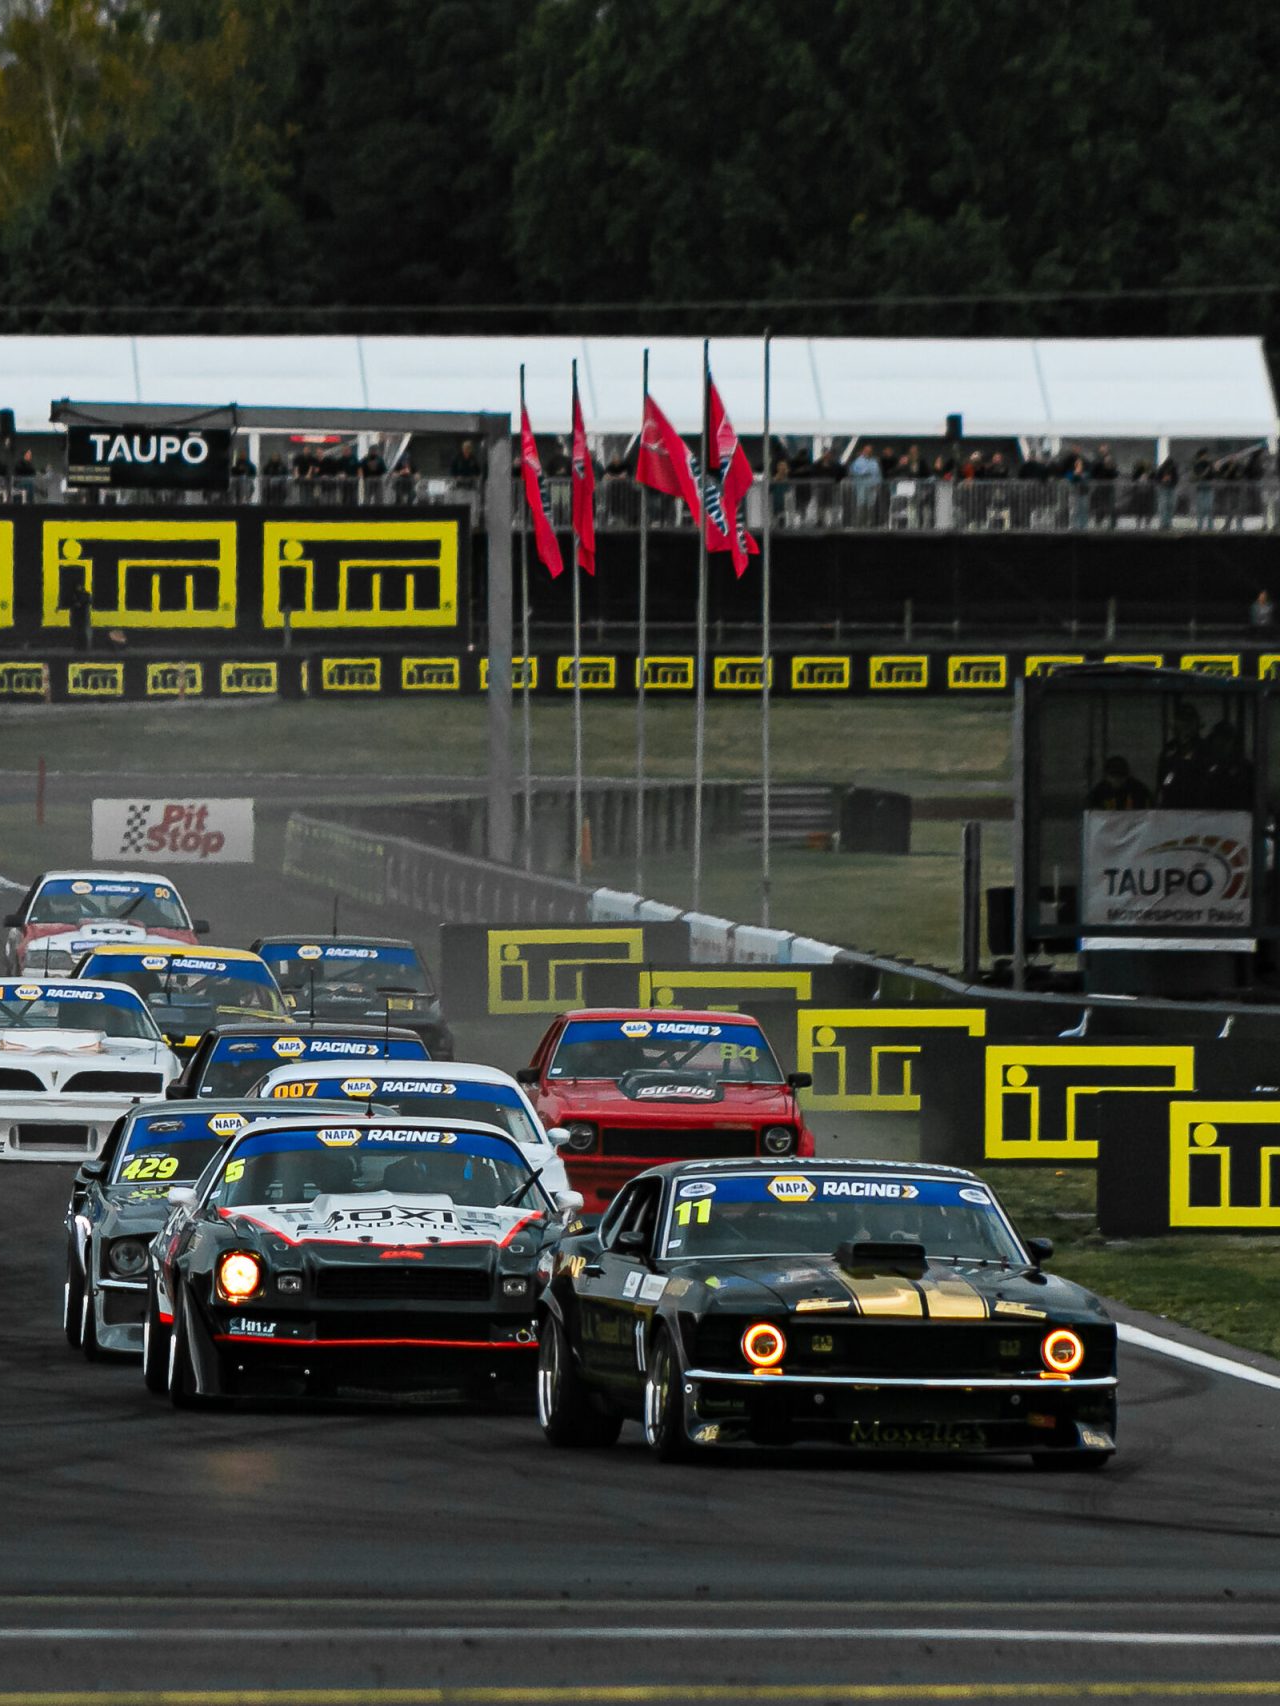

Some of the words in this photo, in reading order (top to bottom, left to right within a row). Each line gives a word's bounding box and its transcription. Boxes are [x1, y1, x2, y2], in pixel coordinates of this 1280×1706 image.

[89, 431, 208, 464] TAUPŌ
[164, 804, 208, 832] Pit
[144, 827, 225, 858] Stop
[1104, 862, 1213, 896] TAUPŌ
[46, 988, 94, 1000] RACING
[656, 1022, 712, 1036] RACING
[278, 1042, 301, 1051] NAPA
[310, 1041, 367, 1055] RACING
[274, 1082, 319, 1098] 007
[346, 1082, 371, 1092] NAPA
[381, 1081, 443, 1094] RACING
[215, 1119, 243, 1130] NAPA
[324, 1130, 356, 1141] NAPA
[368, 1129, 441, 1144] RACING
[121, 1157, 179, 1180] 429
[224, 1158, 245, 1184] 5
[774, 1181, 810, 1196] NAPA
[822, 1180, 900, 1198] RACING
[674, 1197, 713, 1226] 11
